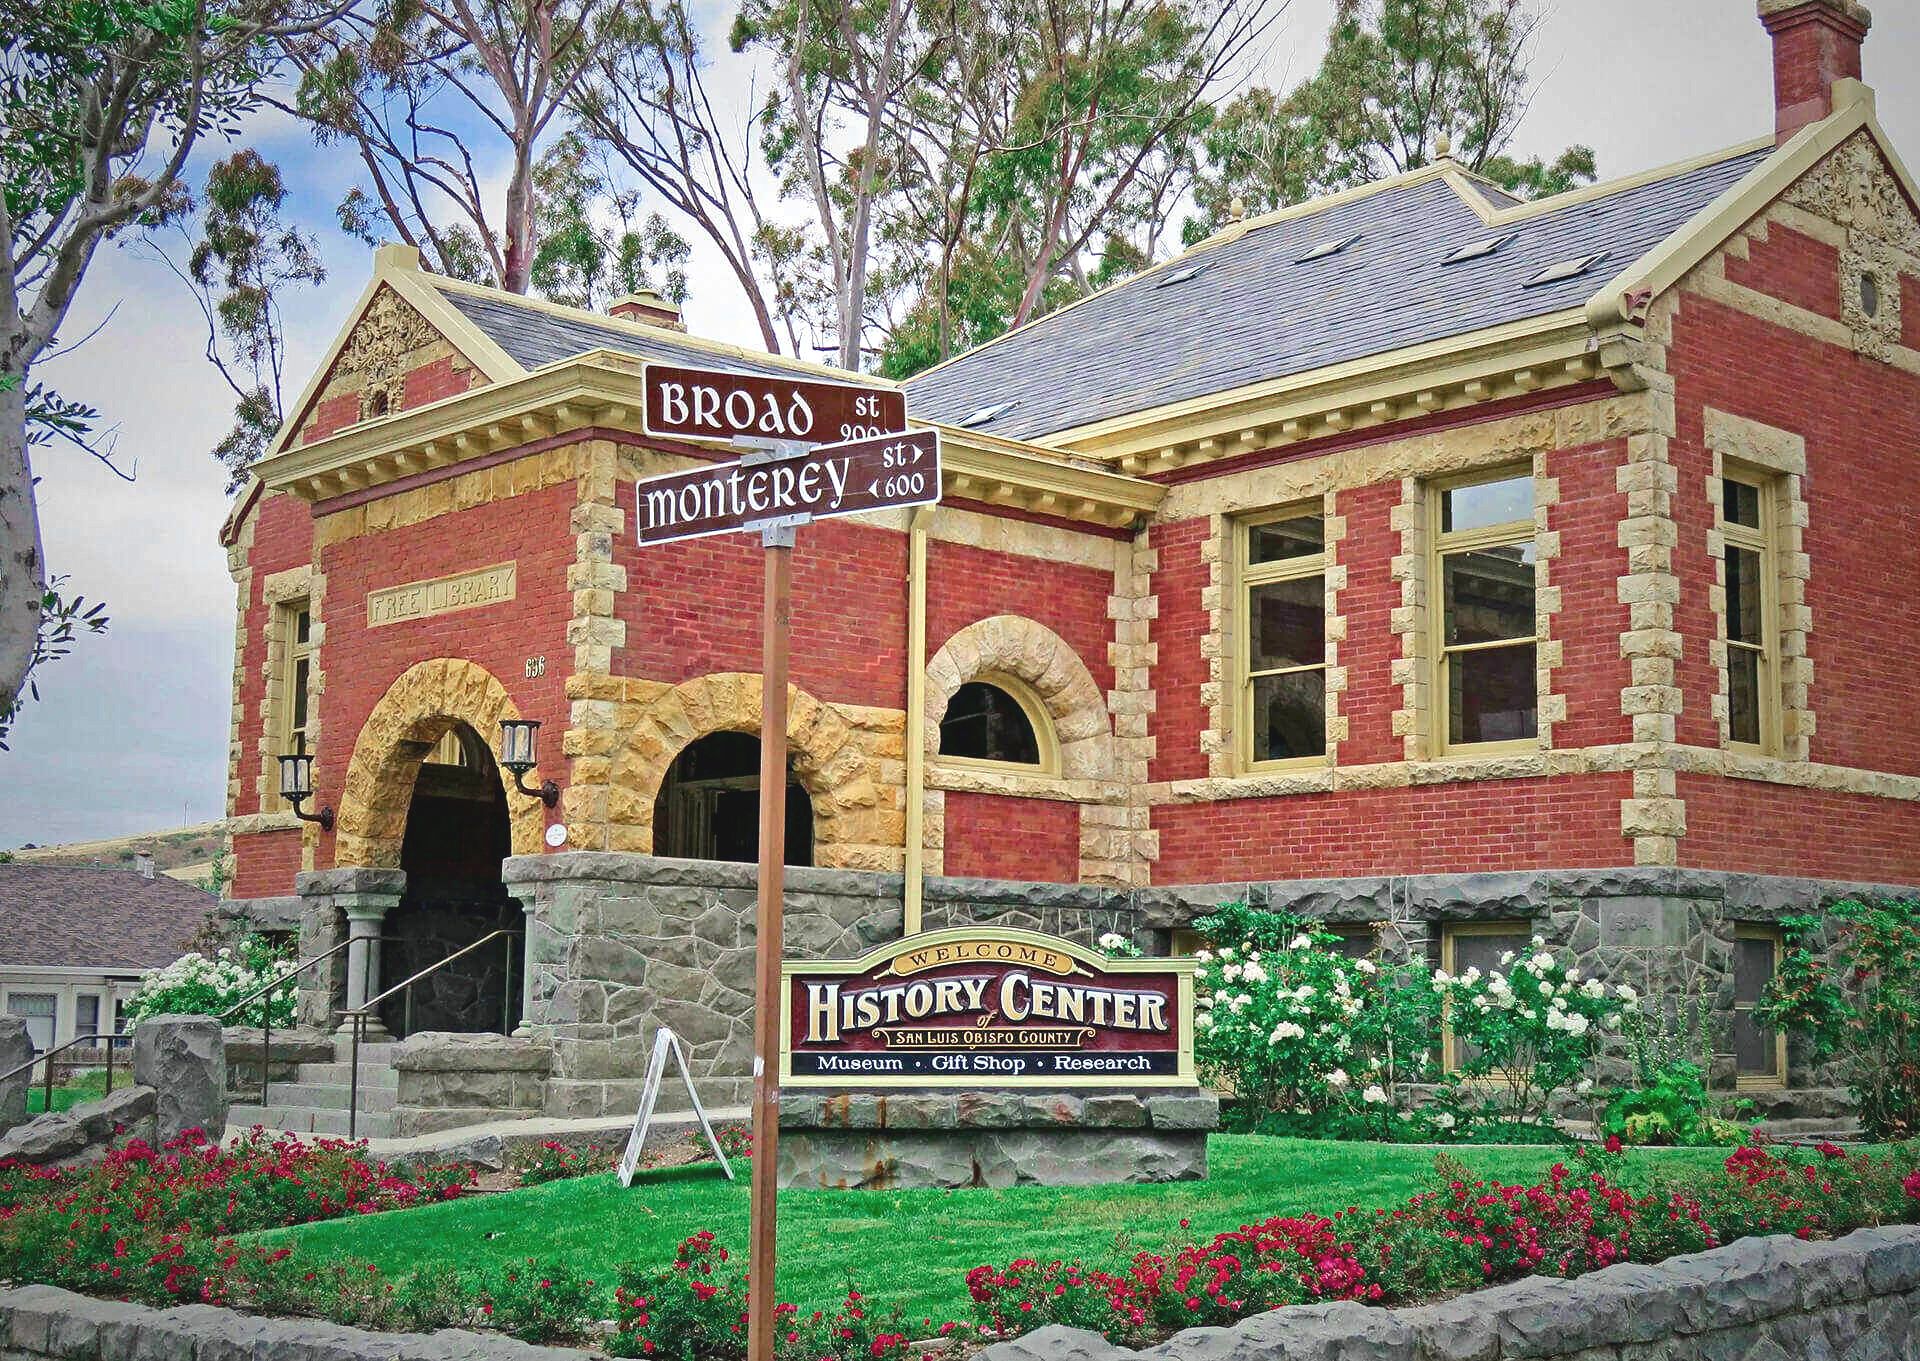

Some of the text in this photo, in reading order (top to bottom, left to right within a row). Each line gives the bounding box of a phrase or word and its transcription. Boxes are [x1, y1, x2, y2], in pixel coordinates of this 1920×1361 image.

[885, 472, 925, 498] 600
[370, 567, 514, 622] FREE LIBRARY
[909, 943, 1057, 968] WELCOME
[803, 972, 1167, 1042] HISTORY CENTER
[975, 1009, 999, 1029] of
[896, 1031, 1072, 1050] SAN LUIS OBISPO COUNTY
[817, 1054, 1152, 1076] Museum Gift Shop Research
